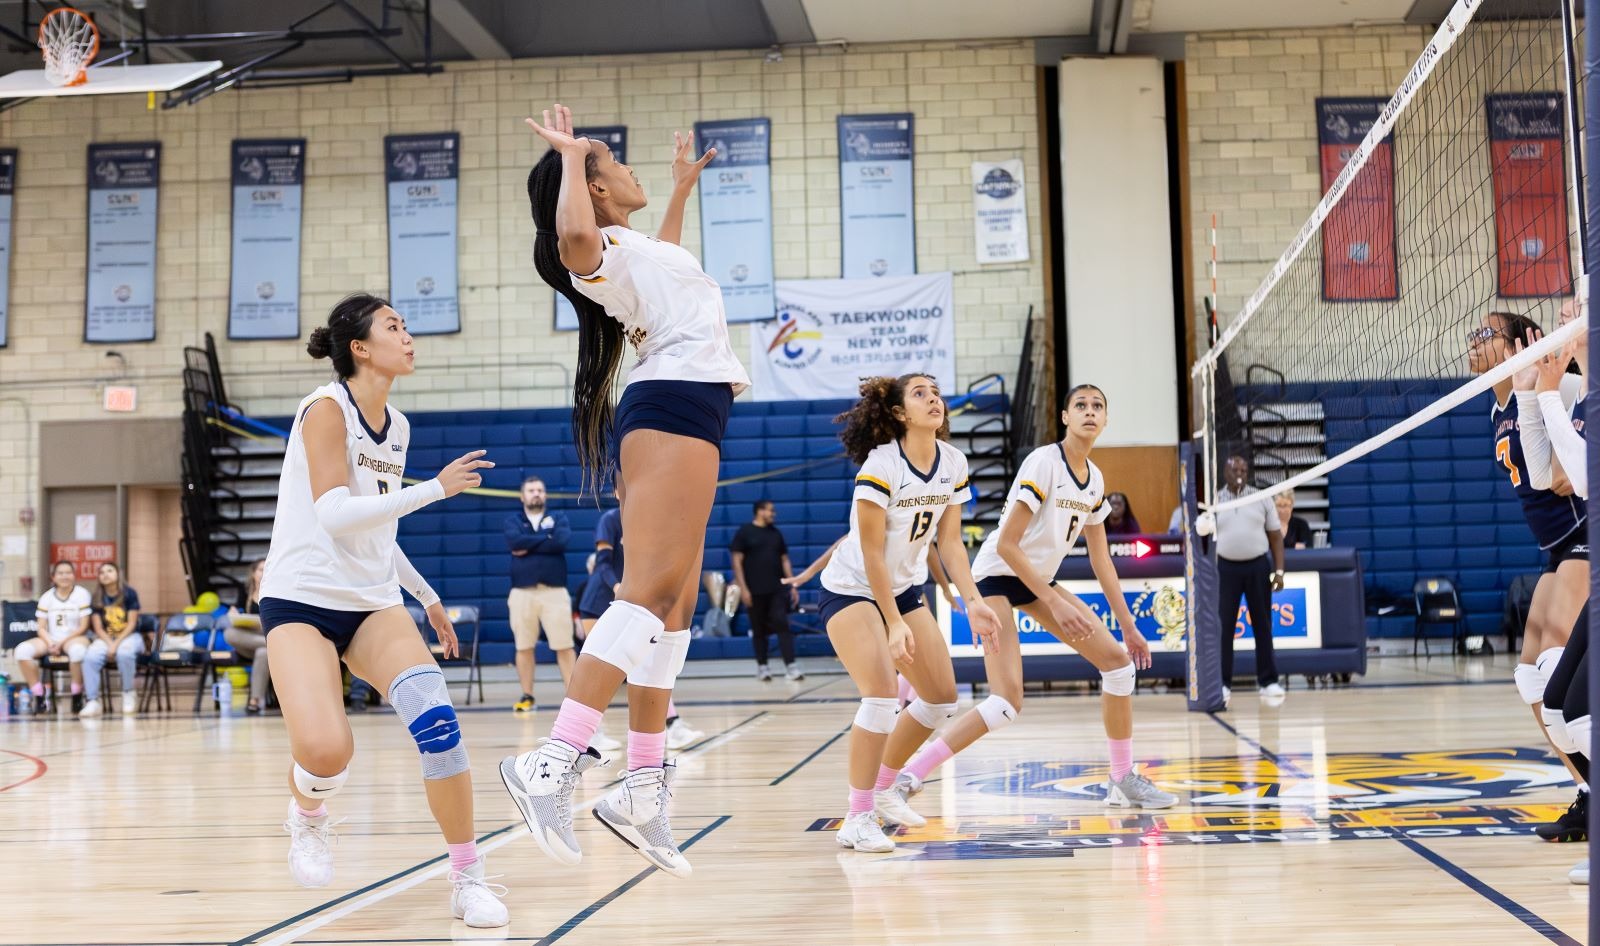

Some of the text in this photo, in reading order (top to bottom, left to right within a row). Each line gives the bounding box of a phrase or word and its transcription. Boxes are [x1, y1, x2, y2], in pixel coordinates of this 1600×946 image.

[831, 306, 943, 325] TAEKWONDO
[870, 326, 906, 336] TEAM
[848, 334, 929, 349] NEW YORK
[1496, 436, 1521, 488] 7
[909, 511, 933, 543] 13
